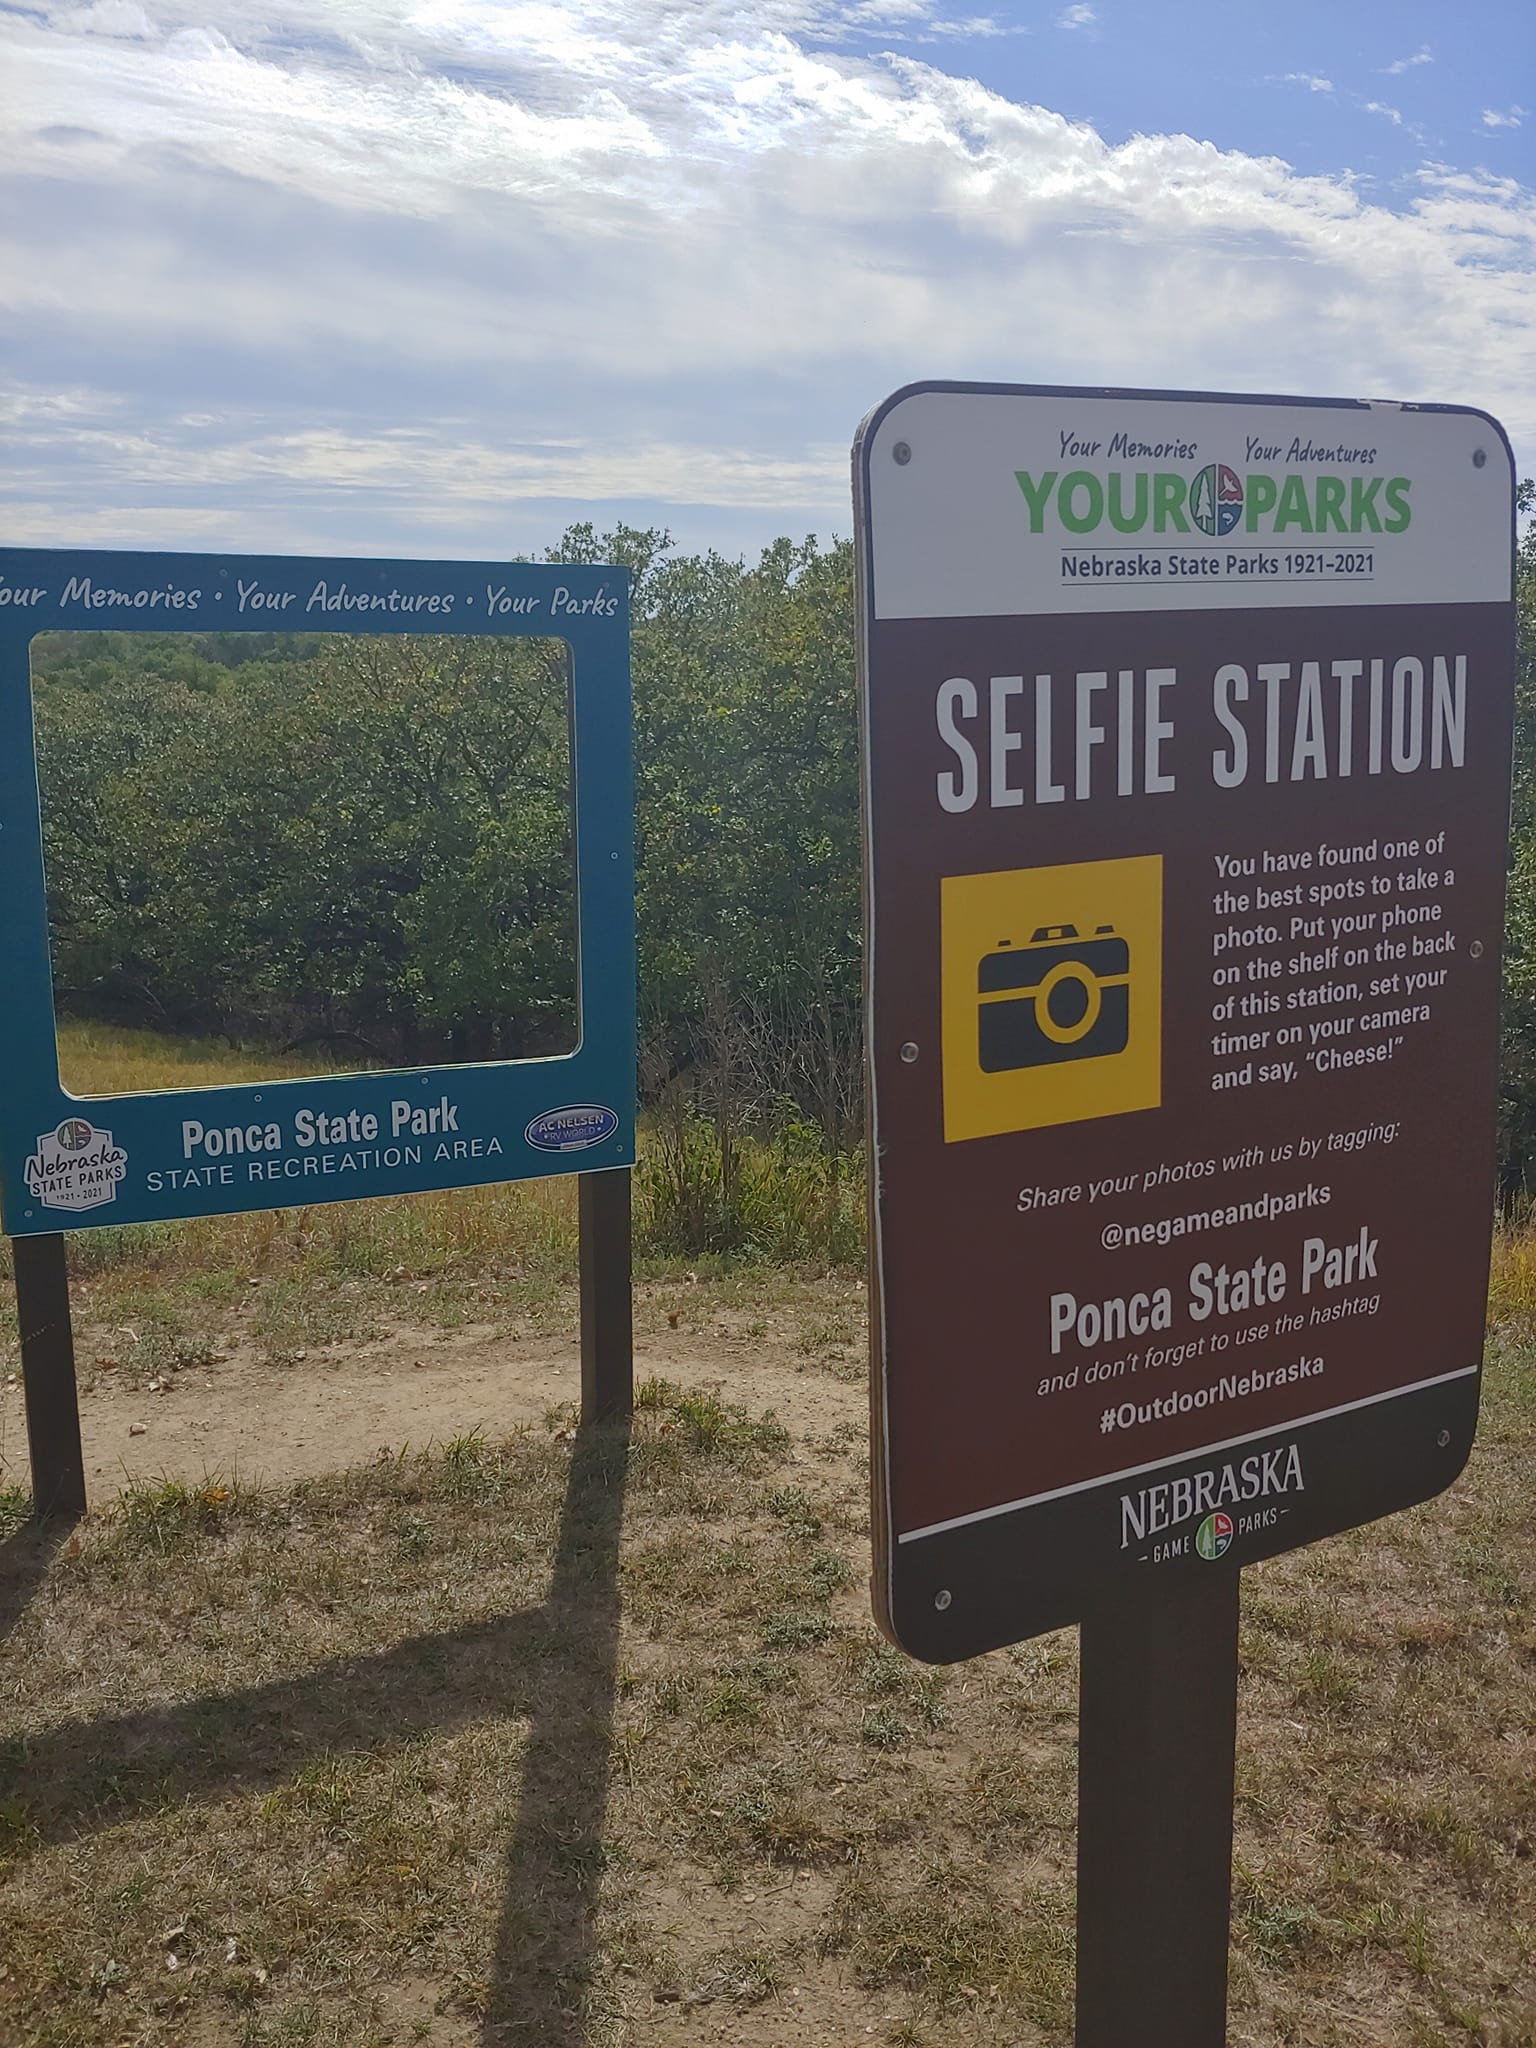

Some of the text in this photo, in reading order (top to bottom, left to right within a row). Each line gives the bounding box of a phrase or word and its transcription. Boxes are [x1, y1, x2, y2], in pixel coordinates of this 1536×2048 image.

[1060, 431, 1198, 460] Your Memories
[1245, 436, 1377, 464] Your Adventures
[1014, 471, 1412, 533] YOUR PARKS
[1061, 555, 1162, 577] Nebraska
[1168, 555, 1219, 575] State
[1226, 554, 1278, 574] Parks
[0, 576, 618, 618] our Memories Your Adventures Your Parks
[936, 655, 1467, 813] SELFIE STATION
[1215, 832, 1445, 878] You have found one of
[1213, 868, 1455, 914] the best spots to take a
[1213, 904, 1441, 956] photo. Put your phone
[1213, 931, 1455, 985] on the shelf on the back
[1212, 969, 1447, 1021] of this station, set your
[1211, 1005, 1430, 1055] timer on your camera
[1212, 1063, 1251, 1090] and
[1258, 1061, 1298, 1083] say,
[182, 1096, 459, 1159] Ponca State Park
[539, 1115, 604, 1133] AC NELSEN
[550, 1127, 595, 1140] RV WORLD
[27, 1144, 124, 1181] Nebraska
[32, 1165, 122, 1195] STATE PARKS
[146, 1136, 503, 1192] STATE RECREATION AREA
[1016, 1121, 1401, 1211] Share your photos with us by tagging:
[83, 1187, 102, 1198] 2021
[1101, 1183, 1331, 1250] @negameandparks
[1050, 1226, 1379, 1354] Ponca State Park
[1036, 1367, 1078, 1396] and
[1144, 1340, 1205, 1370] forget
[1210, 1331, 1229, 1352] to
[1235, 1322, 1268, 1344] use
[1275, 1312, 1304, 1334] the
[1309, 1293, 1381, 1328] hashtag
[1099, 1355, 1324, 1433] #OutdoorNebraska
[1120, 1444, 1304, 1549] NEBRASKA
[1154, 1508, 1277, 1563] GAME PARKS
